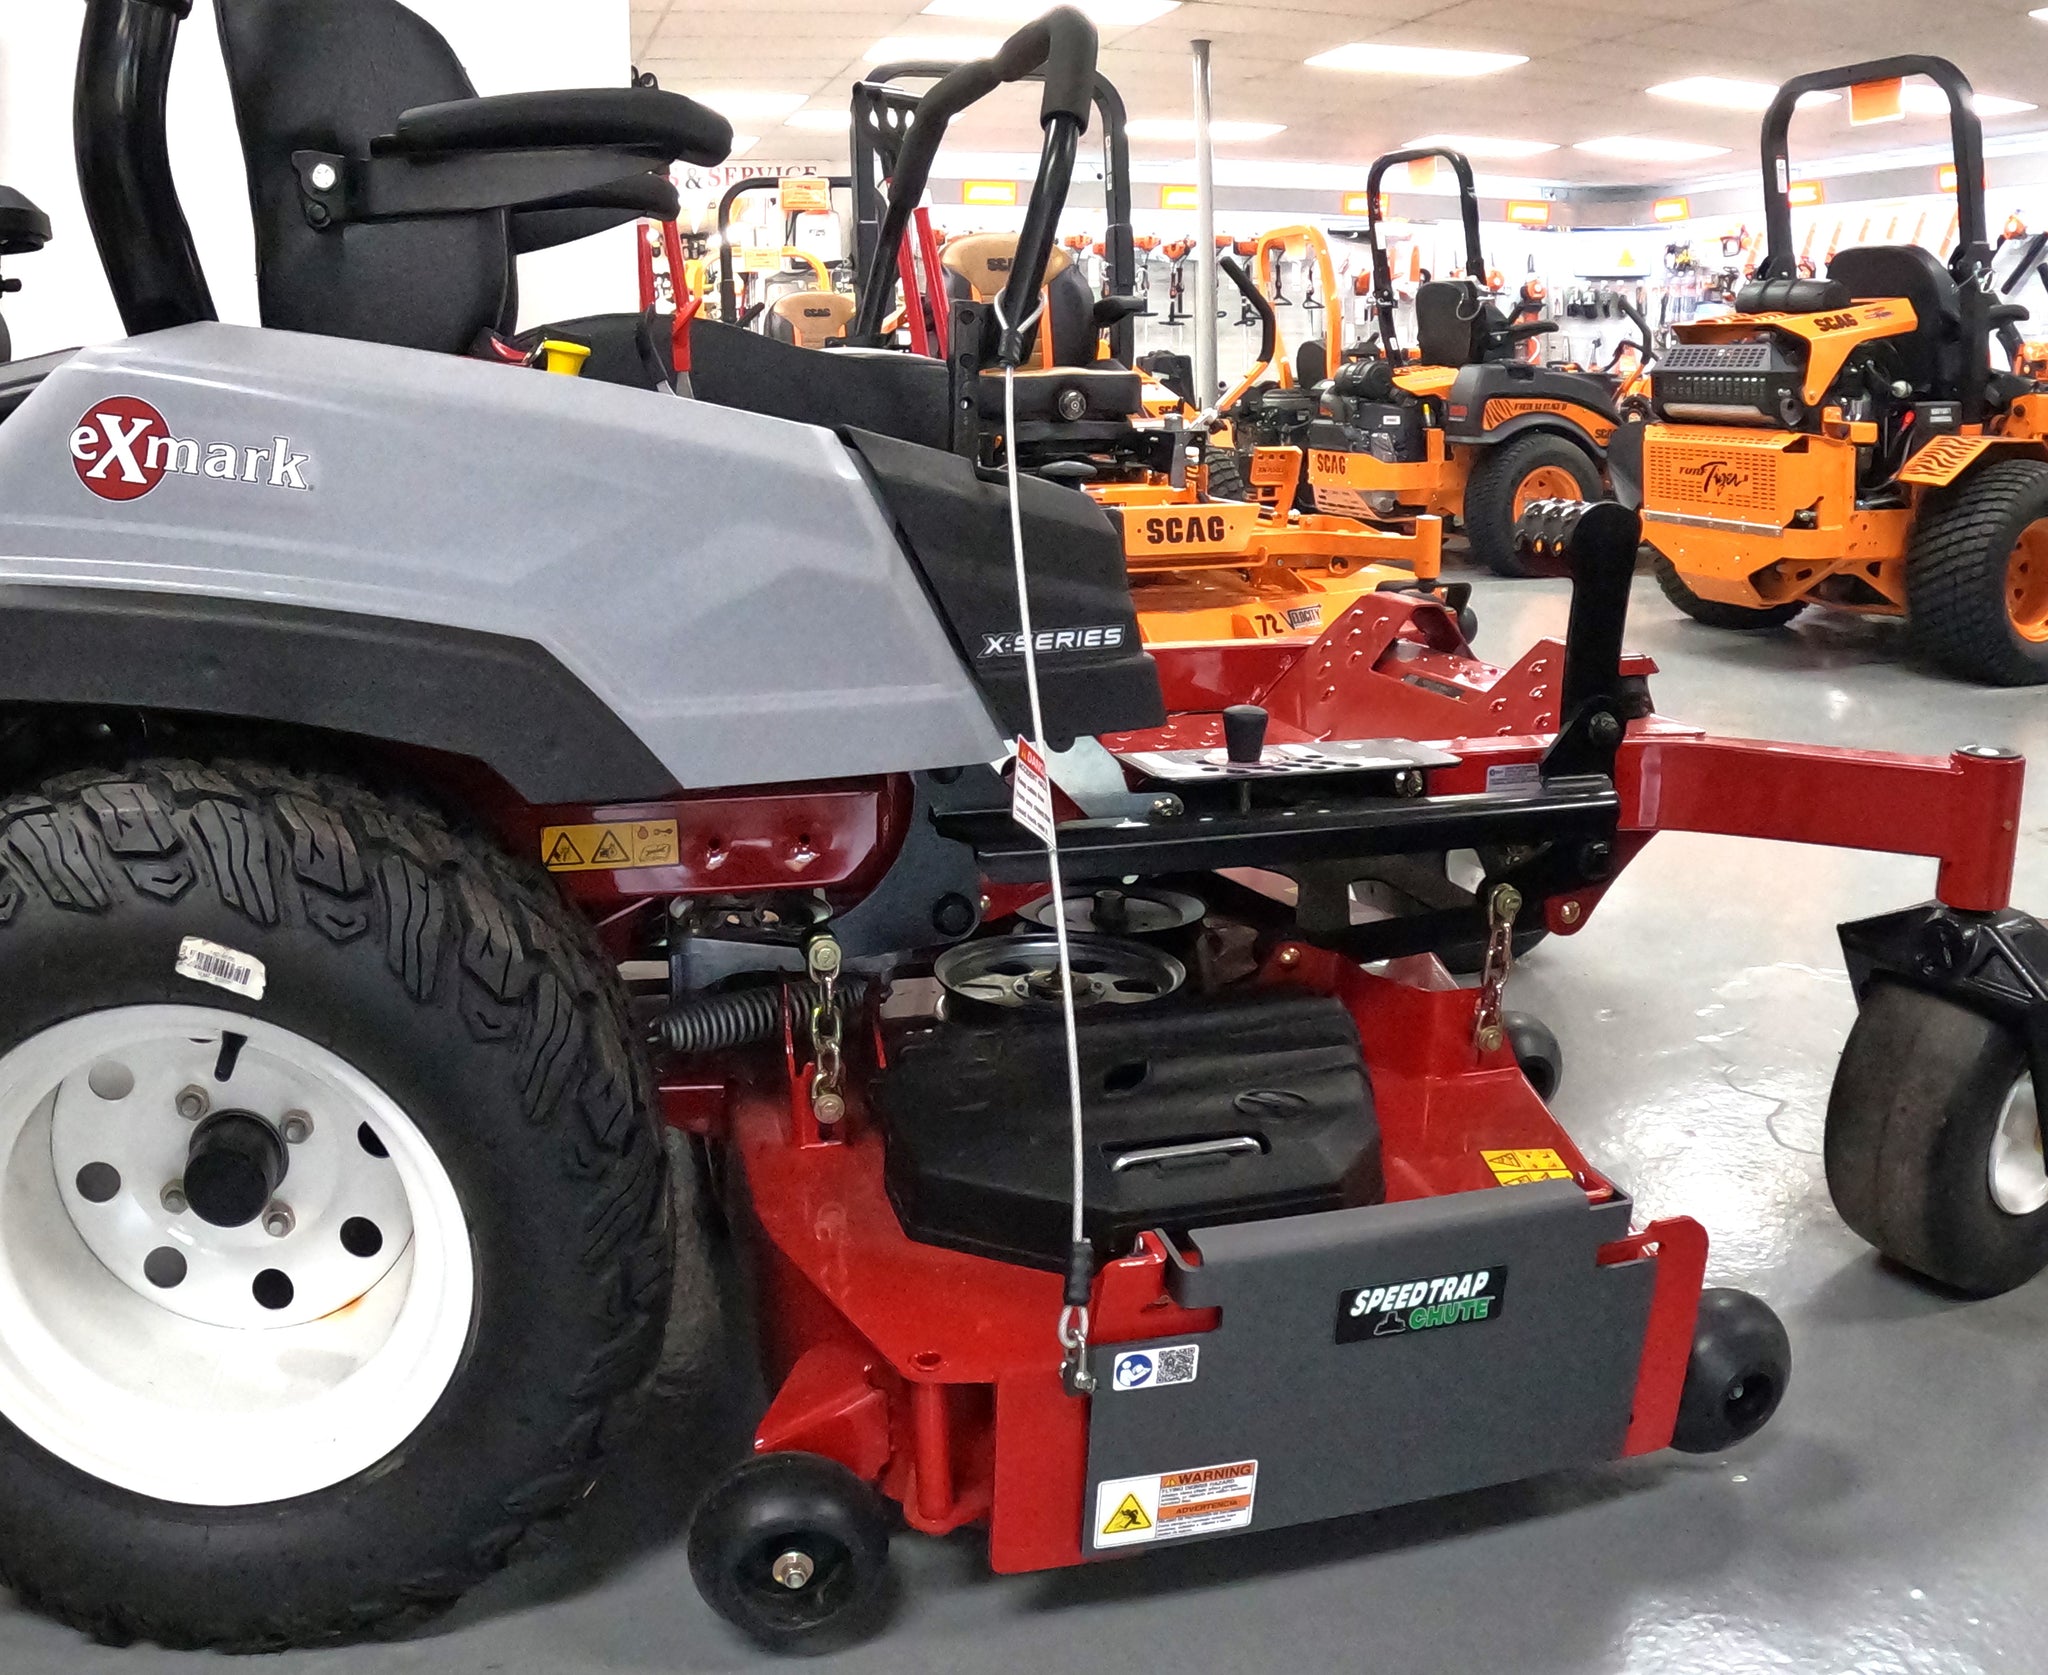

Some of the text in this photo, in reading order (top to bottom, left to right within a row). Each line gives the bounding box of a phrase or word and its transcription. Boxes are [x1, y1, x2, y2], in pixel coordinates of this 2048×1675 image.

[685, 167, 703, 189] &
[1813, 313, 1859, 332] SCAG
[69, 412, 311, 491] eXmark
[1316, 452, 1347, 475] SCAG
[1146, 515, 1225, 544] SCAG
[1254, 604, 1322, 637] 72 VELOCITY
[983, 627, 1122, 655] X-SERIES
[1350, 1271, 1490, 1317] SPEEDTRAP
[1408, 1297, 1491, 1330] CHUTE
[1178, 1464, 1252, 1485] WARNING
